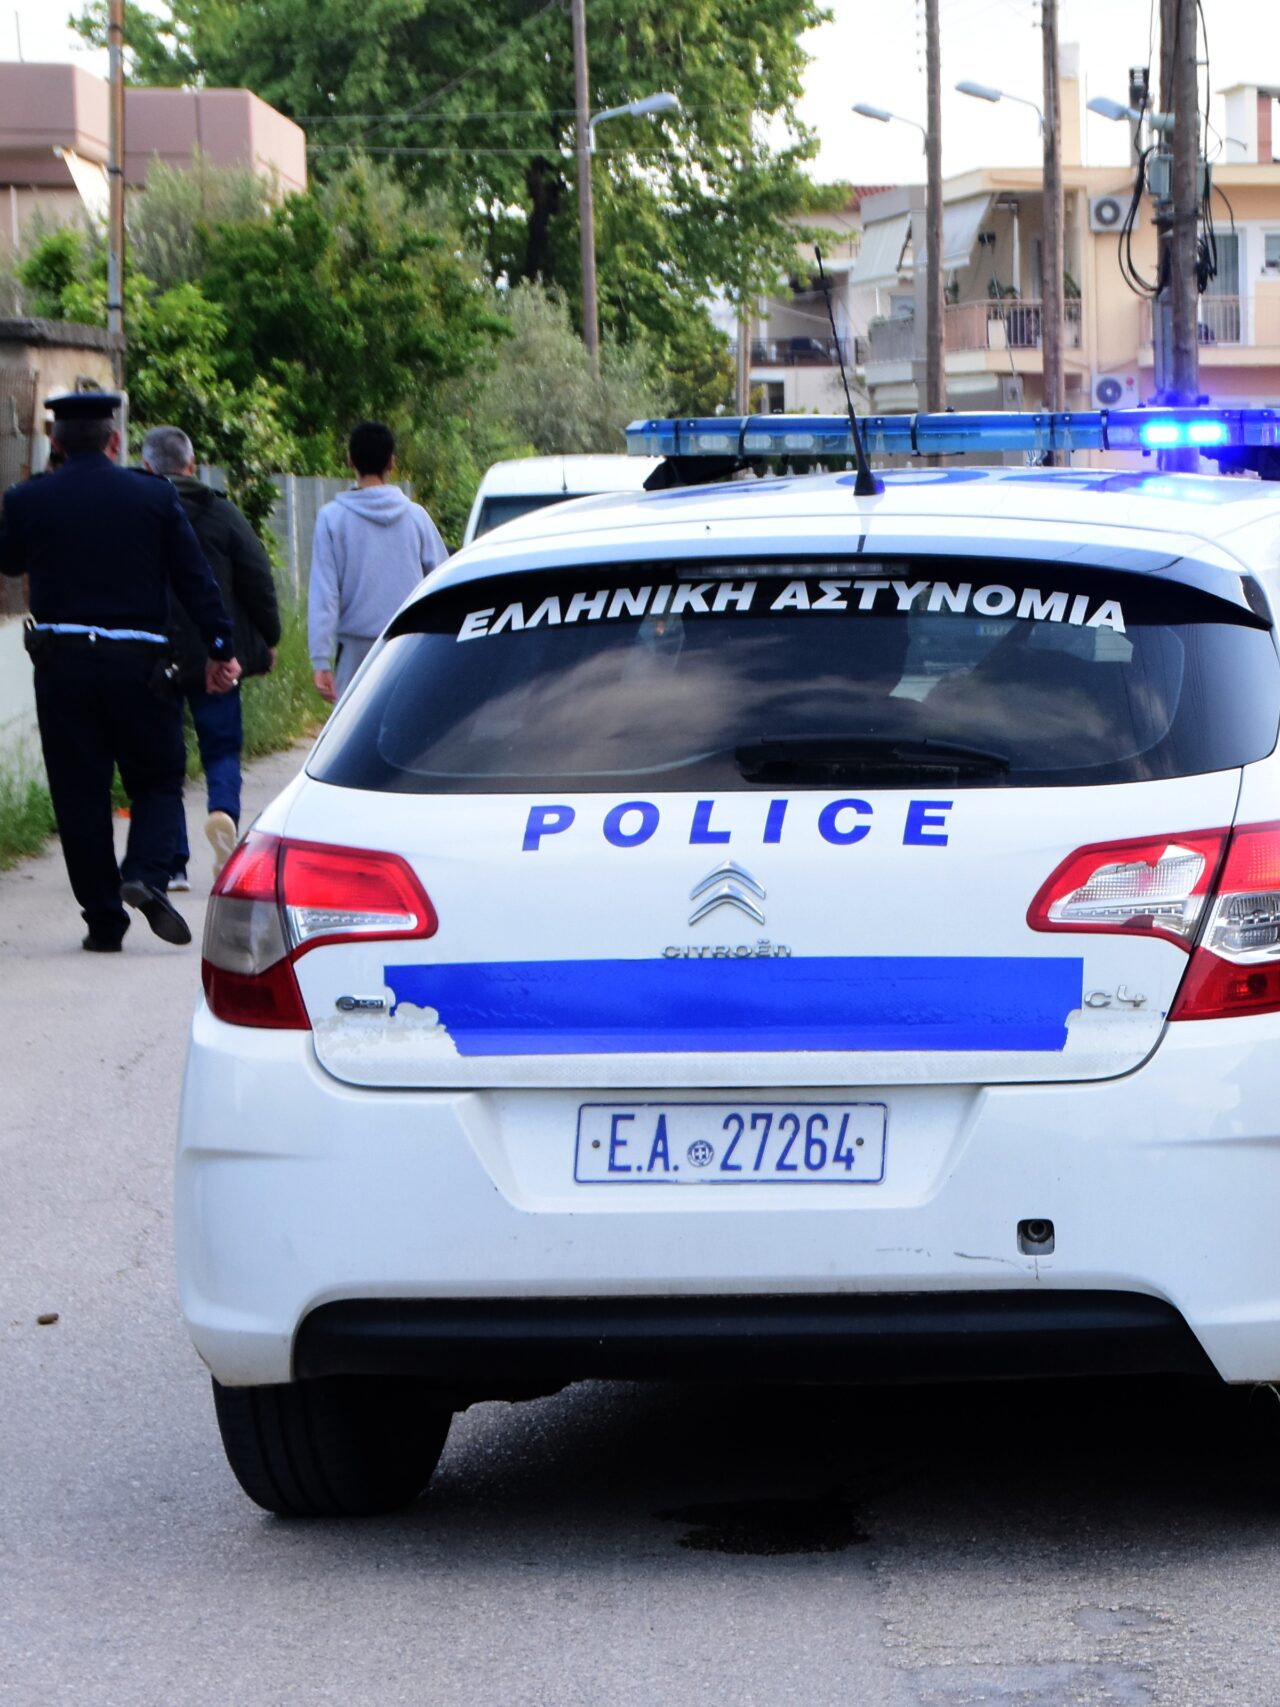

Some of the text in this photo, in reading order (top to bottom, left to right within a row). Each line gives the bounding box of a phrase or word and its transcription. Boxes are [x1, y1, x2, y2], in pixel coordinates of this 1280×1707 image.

[457, 579, 1127, 642] ΕΛΛΗΝΙΚΗ ΑΣΤΥΝΟΜΙΑ
[522, 799, 954, 851] POLICE
[1084, 984, 1147, 1009] C4
[719, 1111, 856, 1172] 27264
